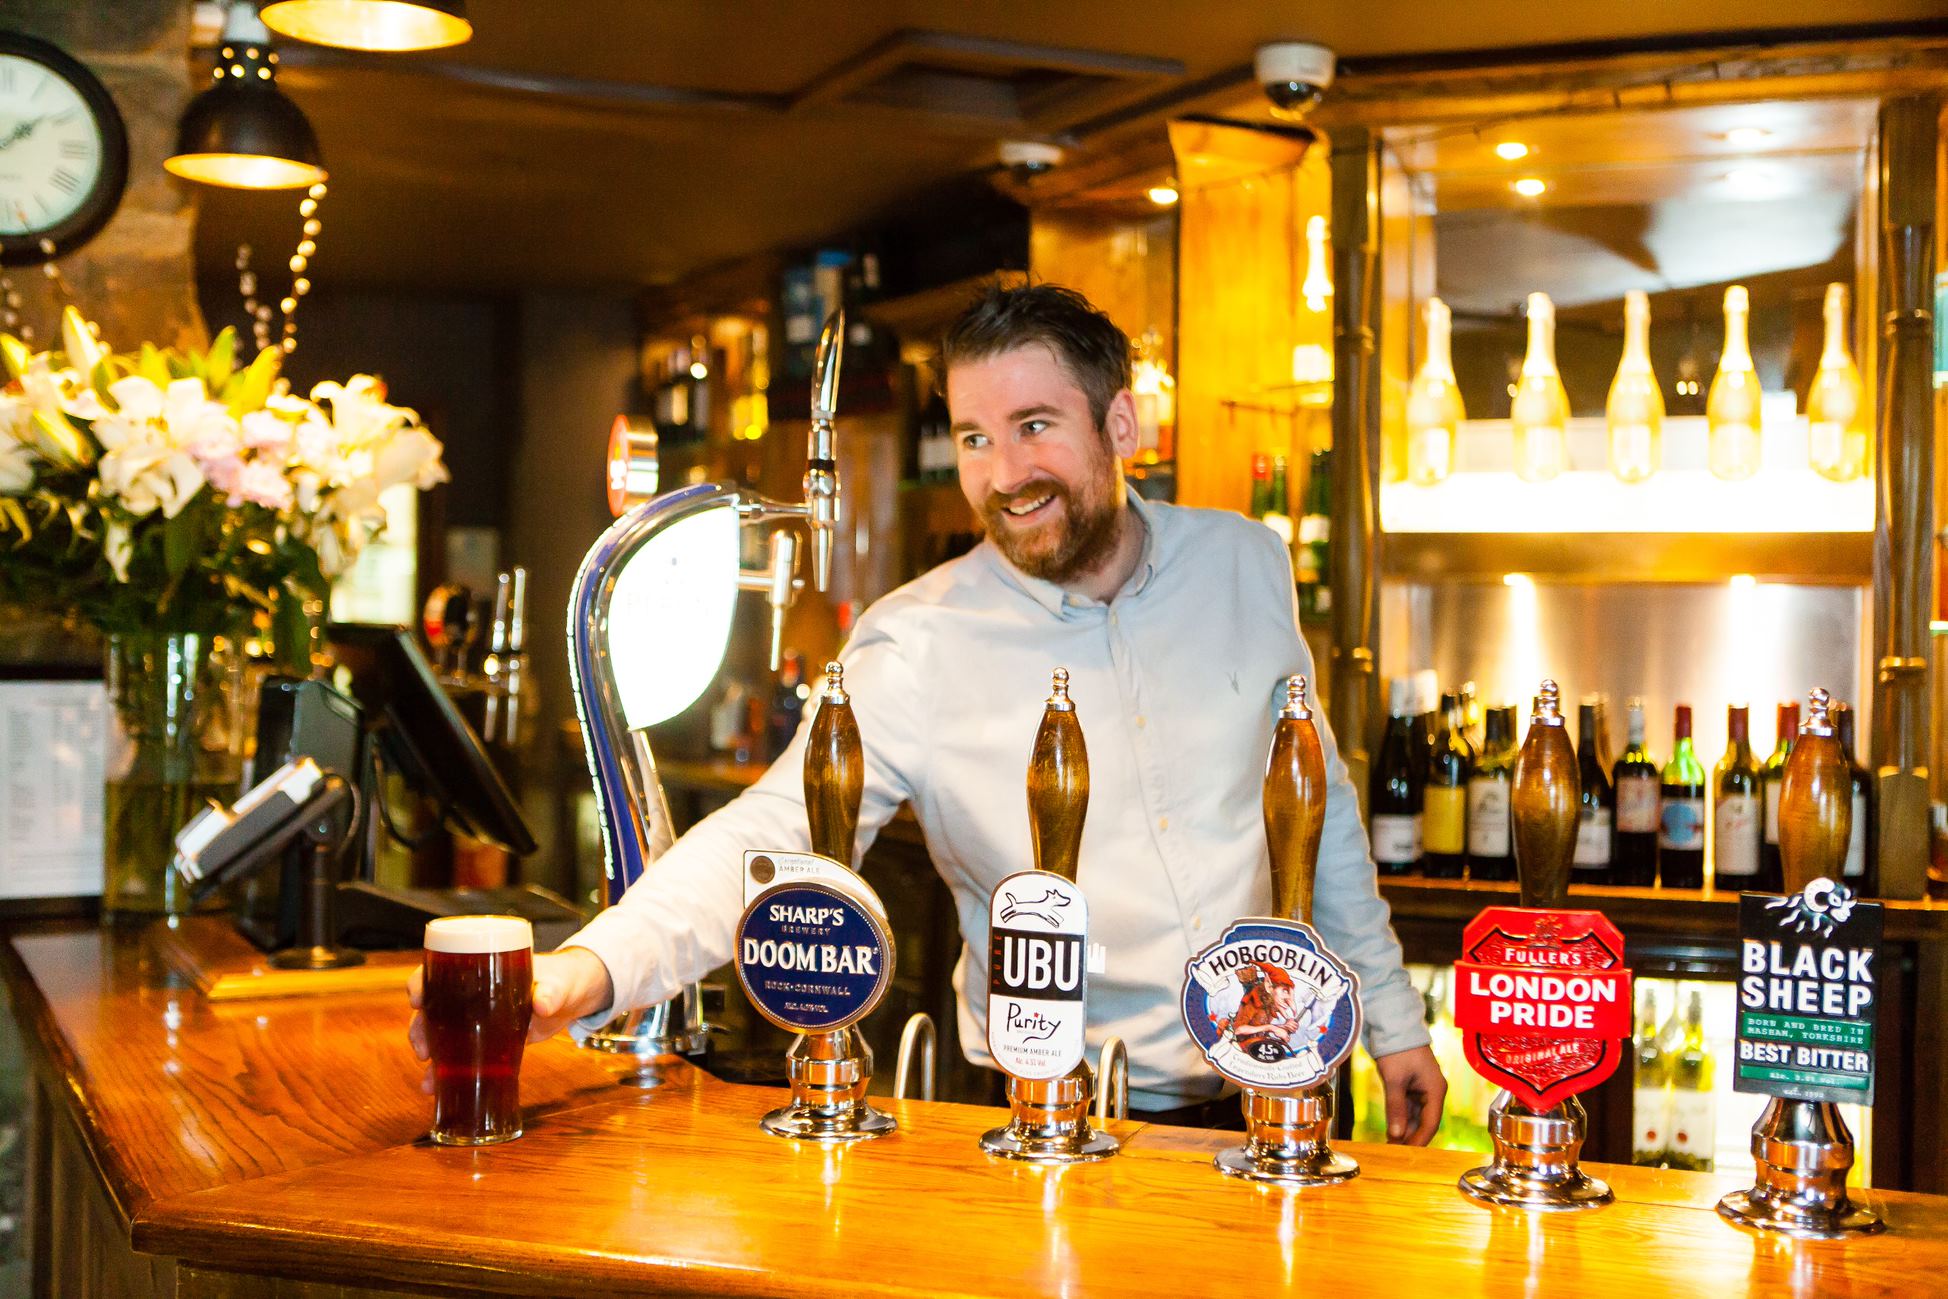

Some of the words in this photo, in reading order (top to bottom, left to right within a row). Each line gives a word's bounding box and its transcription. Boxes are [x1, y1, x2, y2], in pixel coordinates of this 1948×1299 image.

[779, 865, 805, 873] AMBER
[769, 905, 845, 926] SHARP'S
[782, 926, 831, 935] BREWERY
[744, 938, 818, 972] DOOM
[821, 943, 878, 976] BAR
[1003, 936, 1080, 991] UBU
[1208, 944, 1333, 988] HOBGOBLIN
[1504, 947, 1582, 966] FULLER'S
[1742, 938, 1874, 983] BLACK
[1469, 971, 1617, 1003] LONDON
[1741, 976, 1873, 1018] SHEEP
[1006, 1002, 1062, 1044] Purity
[1489, 1000, 1595, 1029] PRIDE
[1747, 1017, 1776, 1027] BORN
[1784, 1021, 1806, 1030] AND
[1813, 1023, 1842, 1033] BRED
[1850, 1027, 1865, 1035] IN
[1003, 1044, 1028, 1055] PREMIUM
[1029, 1048, 1050, 1057] AMBER
[1051, 1050, 1062, 1058] ALE
[1801, 1032, 1865, 1045] YORKSHIRE
[1505, 1047, 1557, 1065] ORIGINAL
[1558, 1042, 1580, 1055] ALE
[1739, 1039, 1792, 1064] BEST
[1796, 1046, 1869, 1073] BITTER
